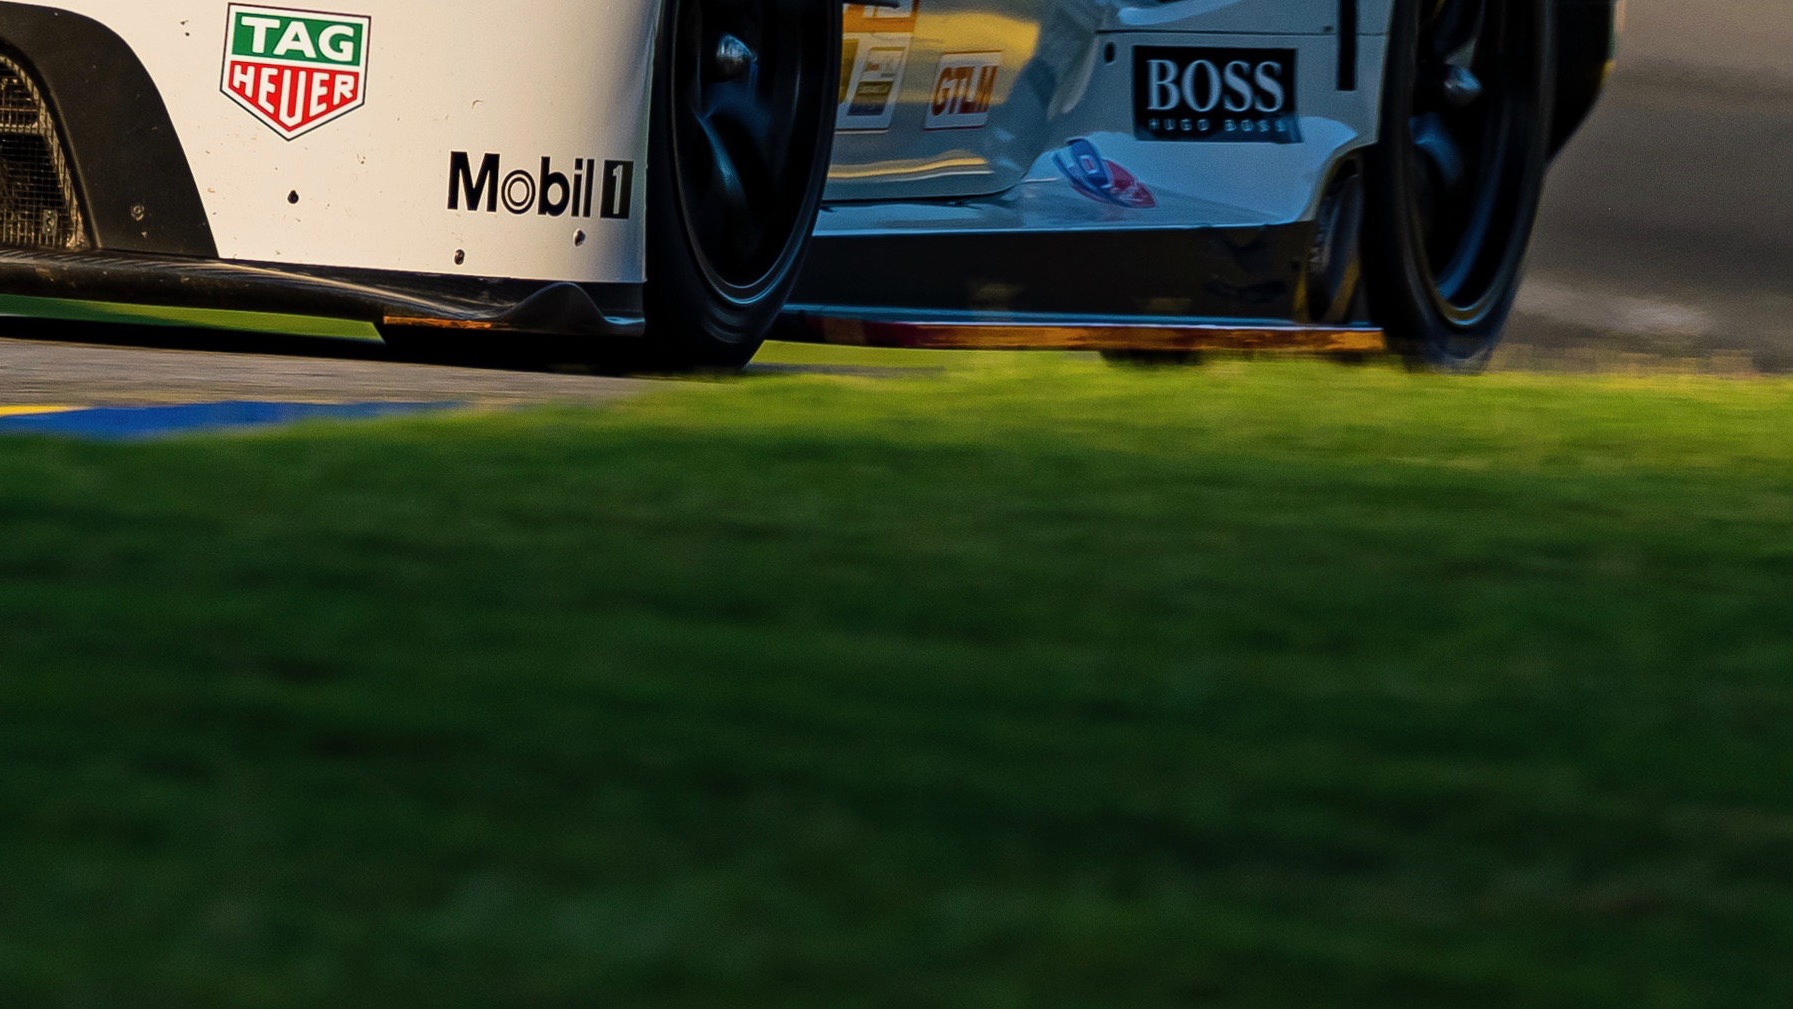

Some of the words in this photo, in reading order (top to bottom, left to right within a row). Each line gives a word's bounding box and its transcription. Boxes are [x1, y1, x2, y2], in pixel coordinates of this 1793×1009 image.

[240, 15, 355, 63] TAG
[232, 64, 356, 128] HEUER
[932, 66, 998, 117] GTLM
[1146, 59, 1285, 113] BOSS
[1148, 118, 1210, 132] HUGO
[1224, 118, 1289, 133] BOSS
[447, 150, 596, 217] Mobil
